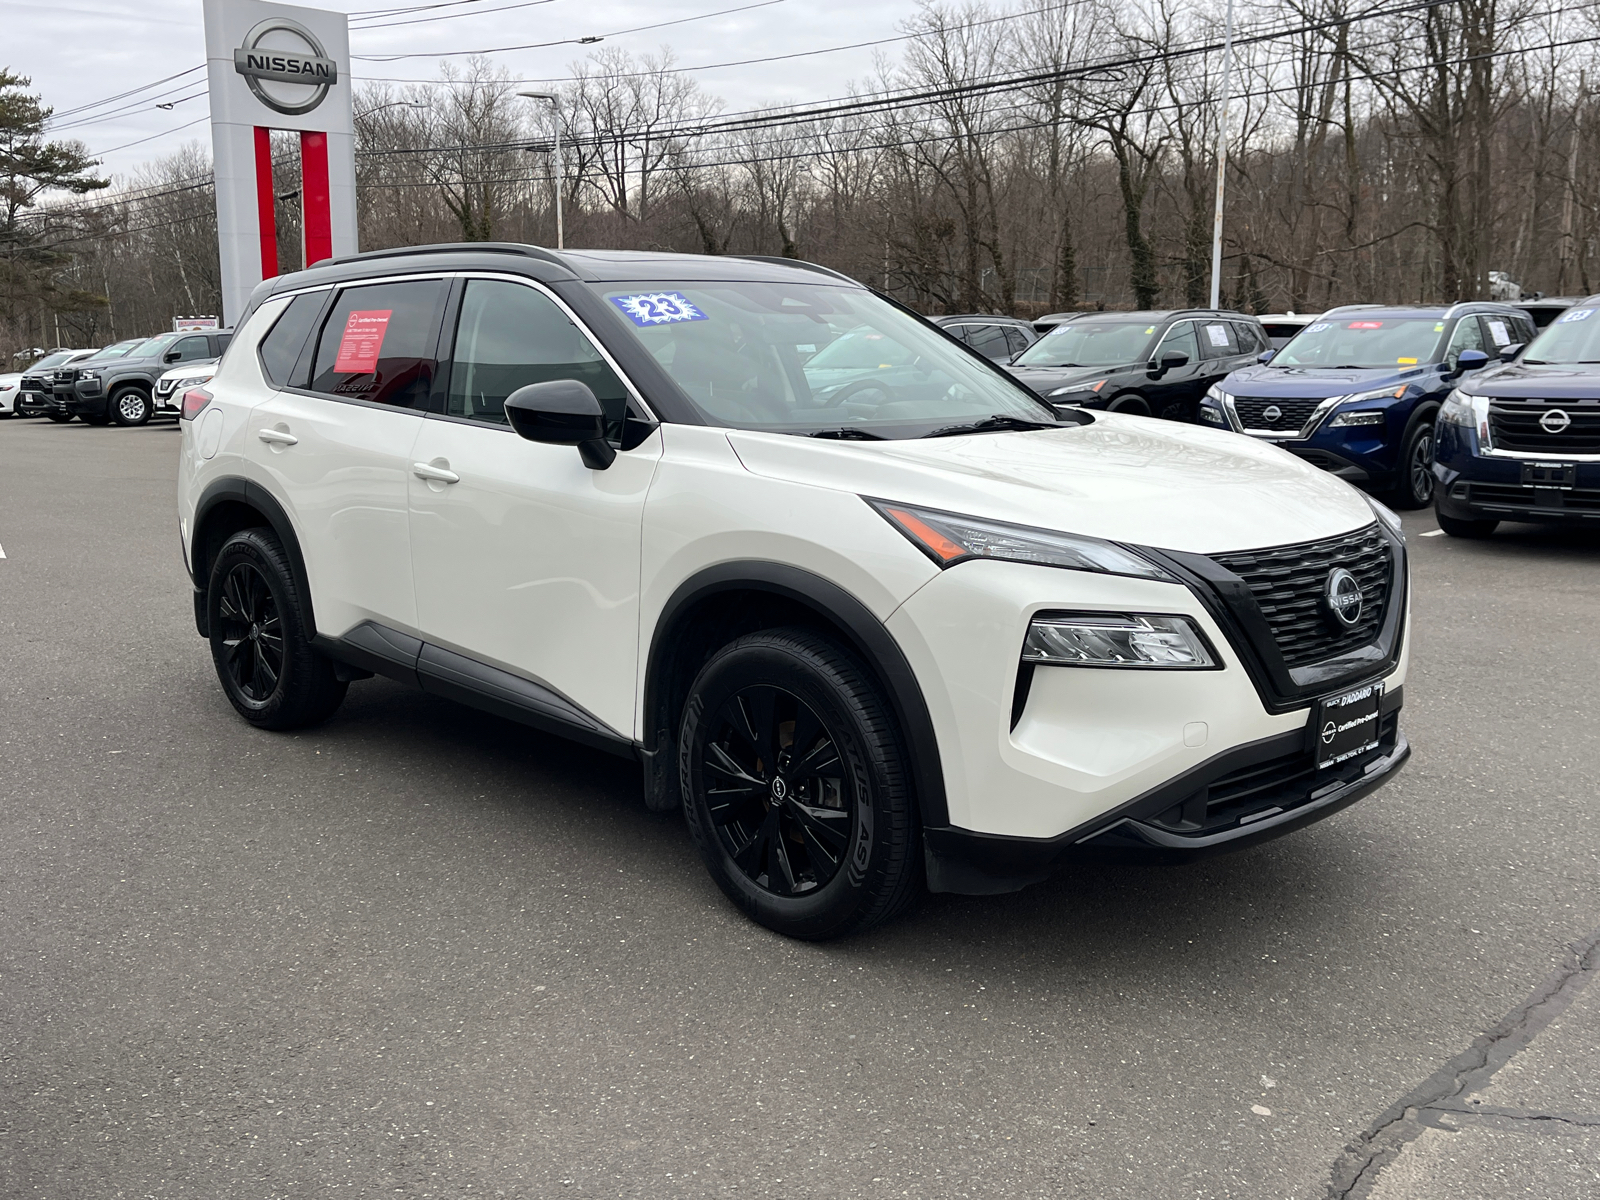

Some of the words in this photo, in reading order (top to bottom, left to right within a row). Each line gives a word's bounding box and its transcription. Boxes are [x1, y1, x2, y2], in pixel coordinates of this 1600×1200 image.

[246, 54, 330, 78] NISSAN
[638, 297, 681, 317] 23
[1330, 592, 1363, 608] NISSAN
[1326, 698, 1340, 707] BUICK
[1341, 687, 1372, 706] D'ADDARIO
[1337, 719, 1357, 732] Certified
[1356, 710, 1379, 725] Pre-Owned
[852, 821, 869, 866] AS
